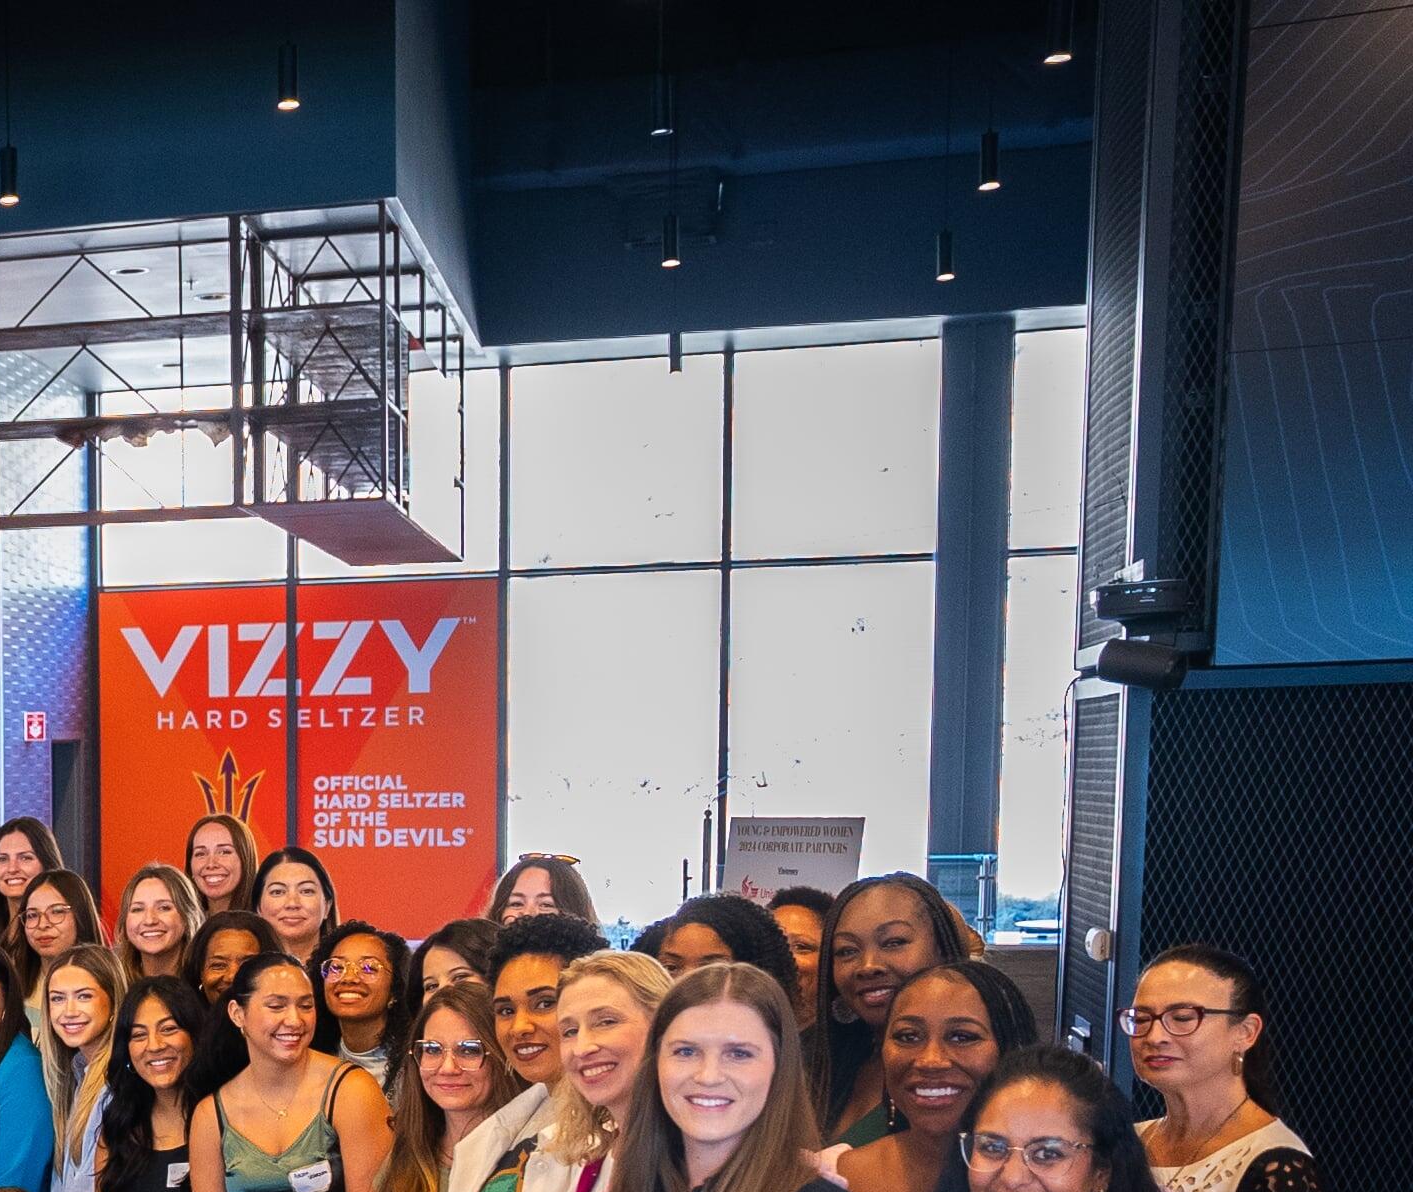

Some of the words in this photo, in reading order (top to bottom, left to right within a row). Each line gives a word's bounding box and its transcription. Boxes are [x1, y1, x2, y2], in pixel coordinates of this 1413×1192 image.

[157, 709, 248, 730] HARD
[268, 705, 425, 729] SELTZER
[313, 775, 407, 792] OFFICIAL
[313, 793, 373, 810] HARD
[377, 792, 466, 809] SELTZER
[313, 811, 342, 827] OF
[347, 811, 388, 827] THE
[313, 829, 365, 848] SUN
[772, 825, 821, 837] EMPOWERED
[823, 826, 854, 838] WOMEN
[757, 841, 805, 853] CORPORATE
[806, 842, 849, 854] PARTNERS
